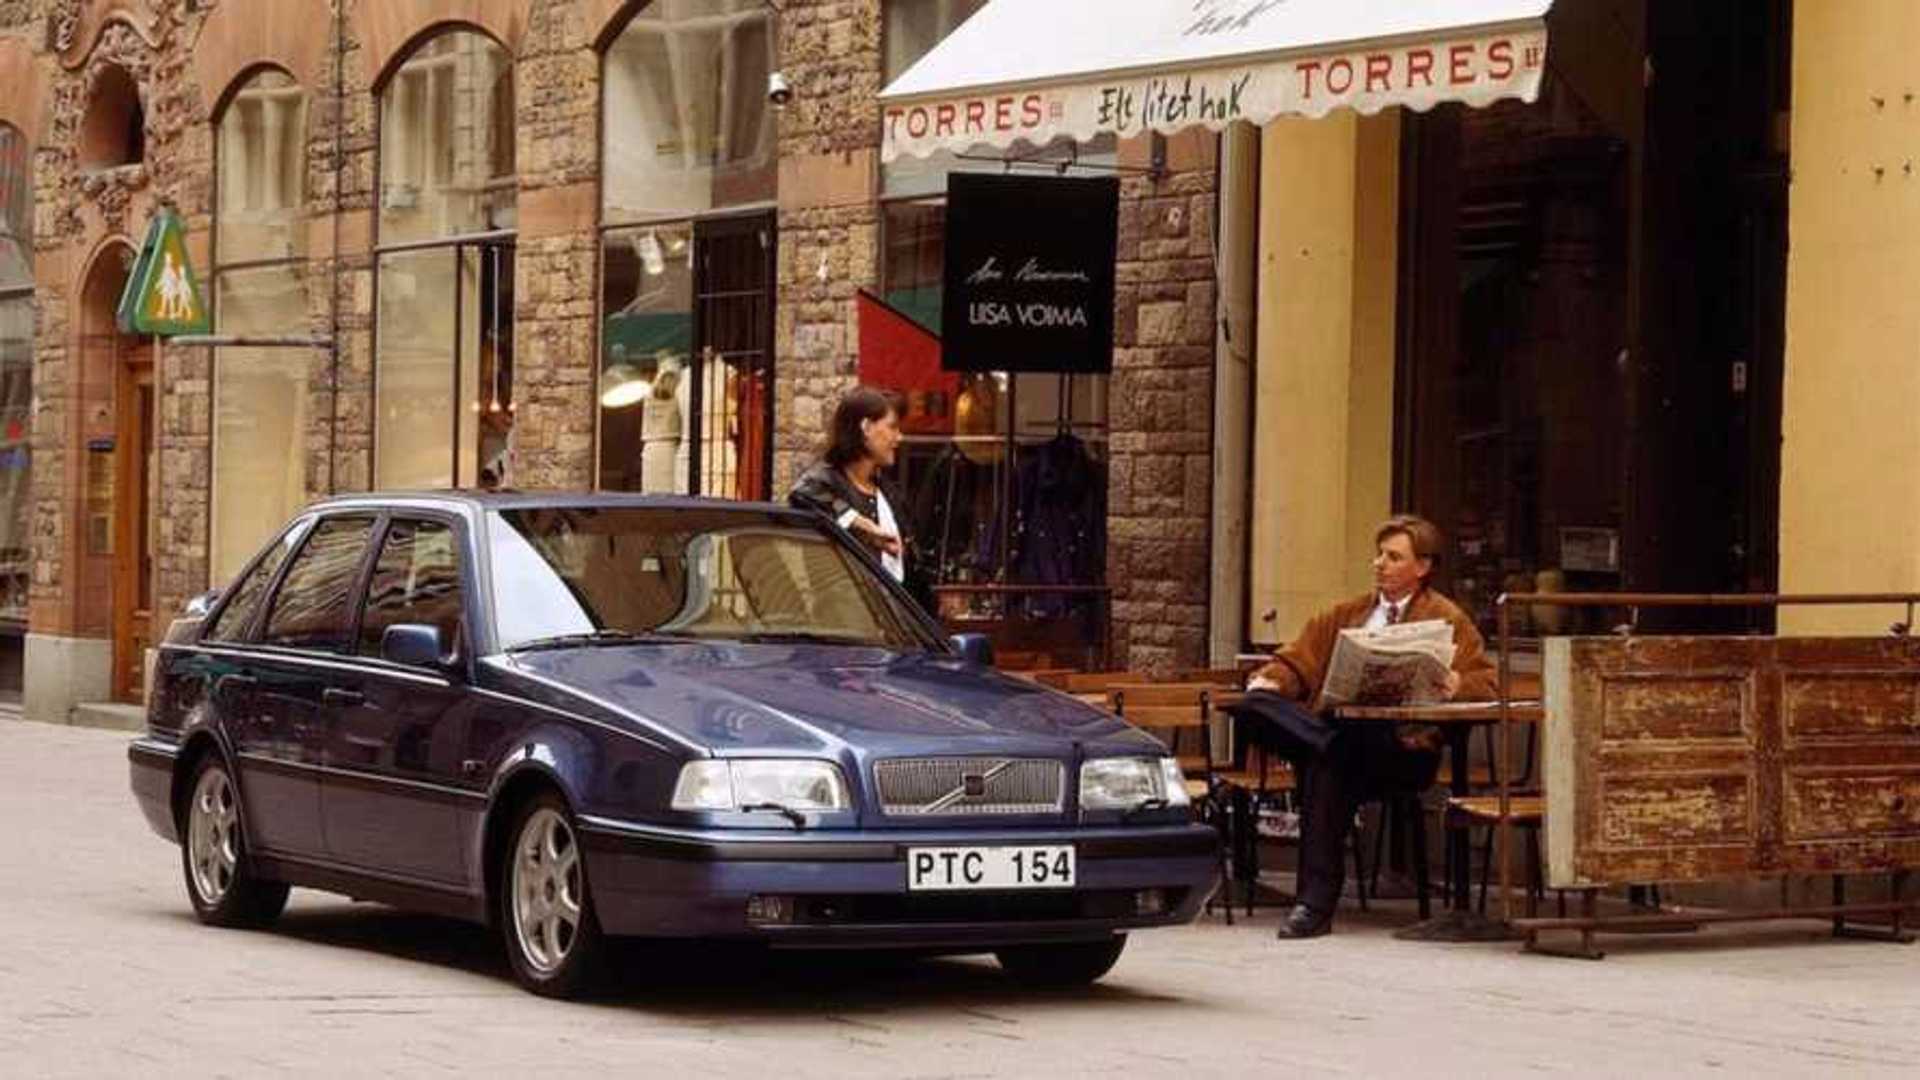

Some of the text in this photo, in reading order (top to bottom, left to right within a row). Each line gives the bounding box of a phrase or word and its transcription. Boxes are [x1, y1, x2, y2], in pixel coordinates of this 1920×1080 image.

[1296, 40, 1514, 98] TORRES
[887, 94, 1042, 140] TORRES
[1016, 303, 1088, 326] VOIMA
[915, 850, 1071, 884] PTC 154
